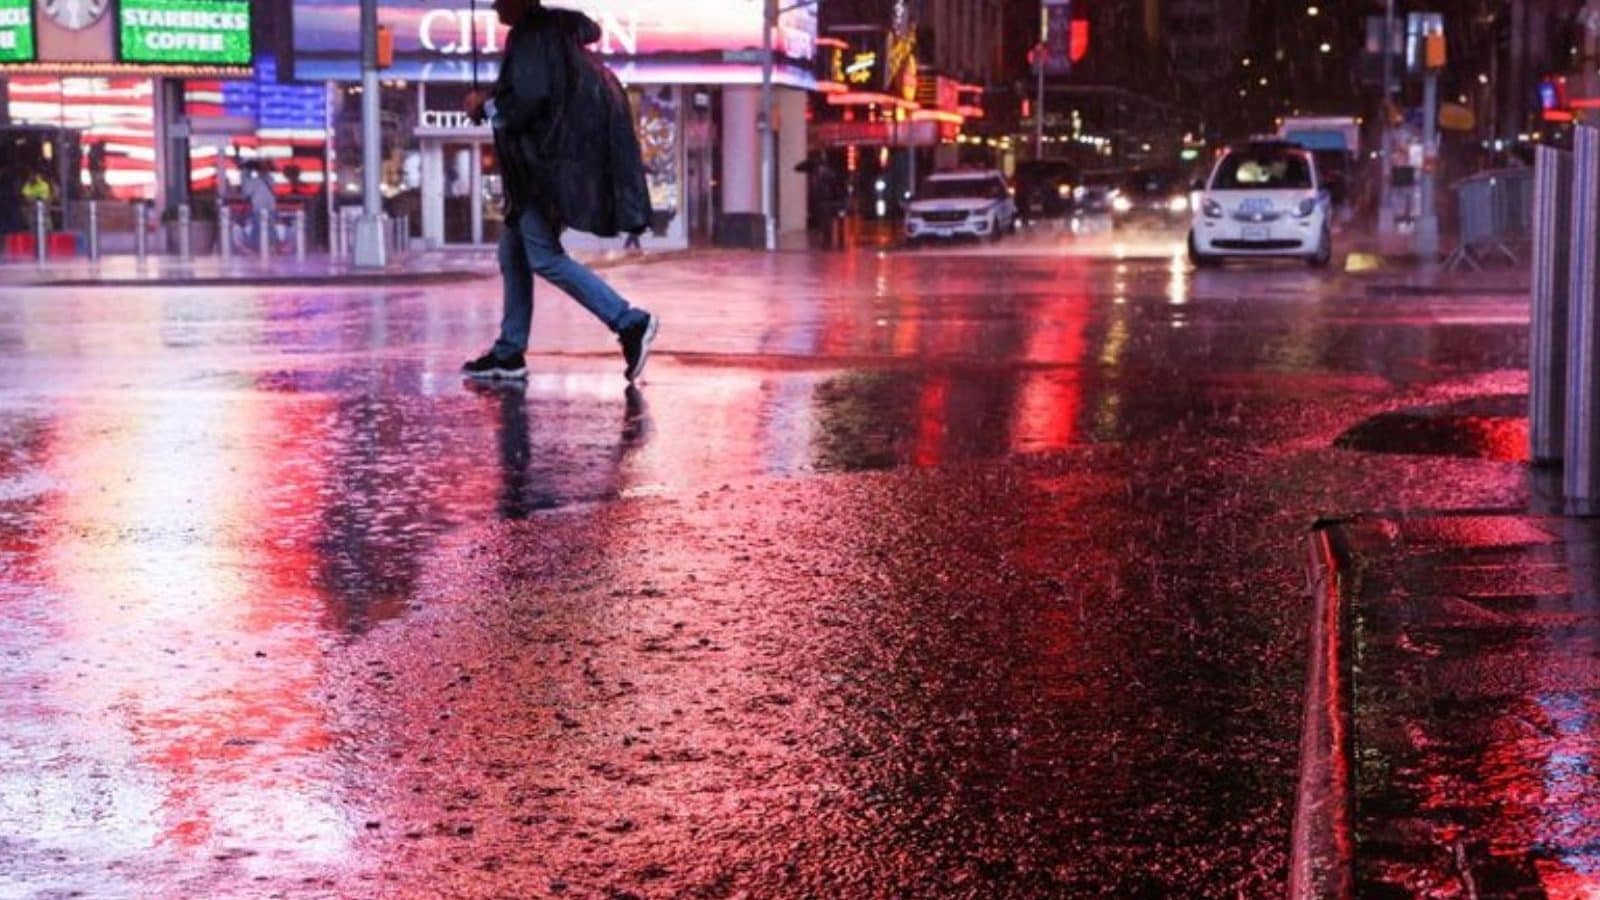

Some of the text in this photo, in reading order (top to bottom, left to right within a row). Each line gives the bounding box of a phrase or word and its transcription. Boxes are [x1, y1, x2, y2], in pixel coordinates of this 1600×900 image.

[122, 9, 248, 29] STARBUCKS
[145, 31, 224, 51] COFFEE
[418, 9, 638, 55] CITN
[421, 110, 492, 128] CITIZ
